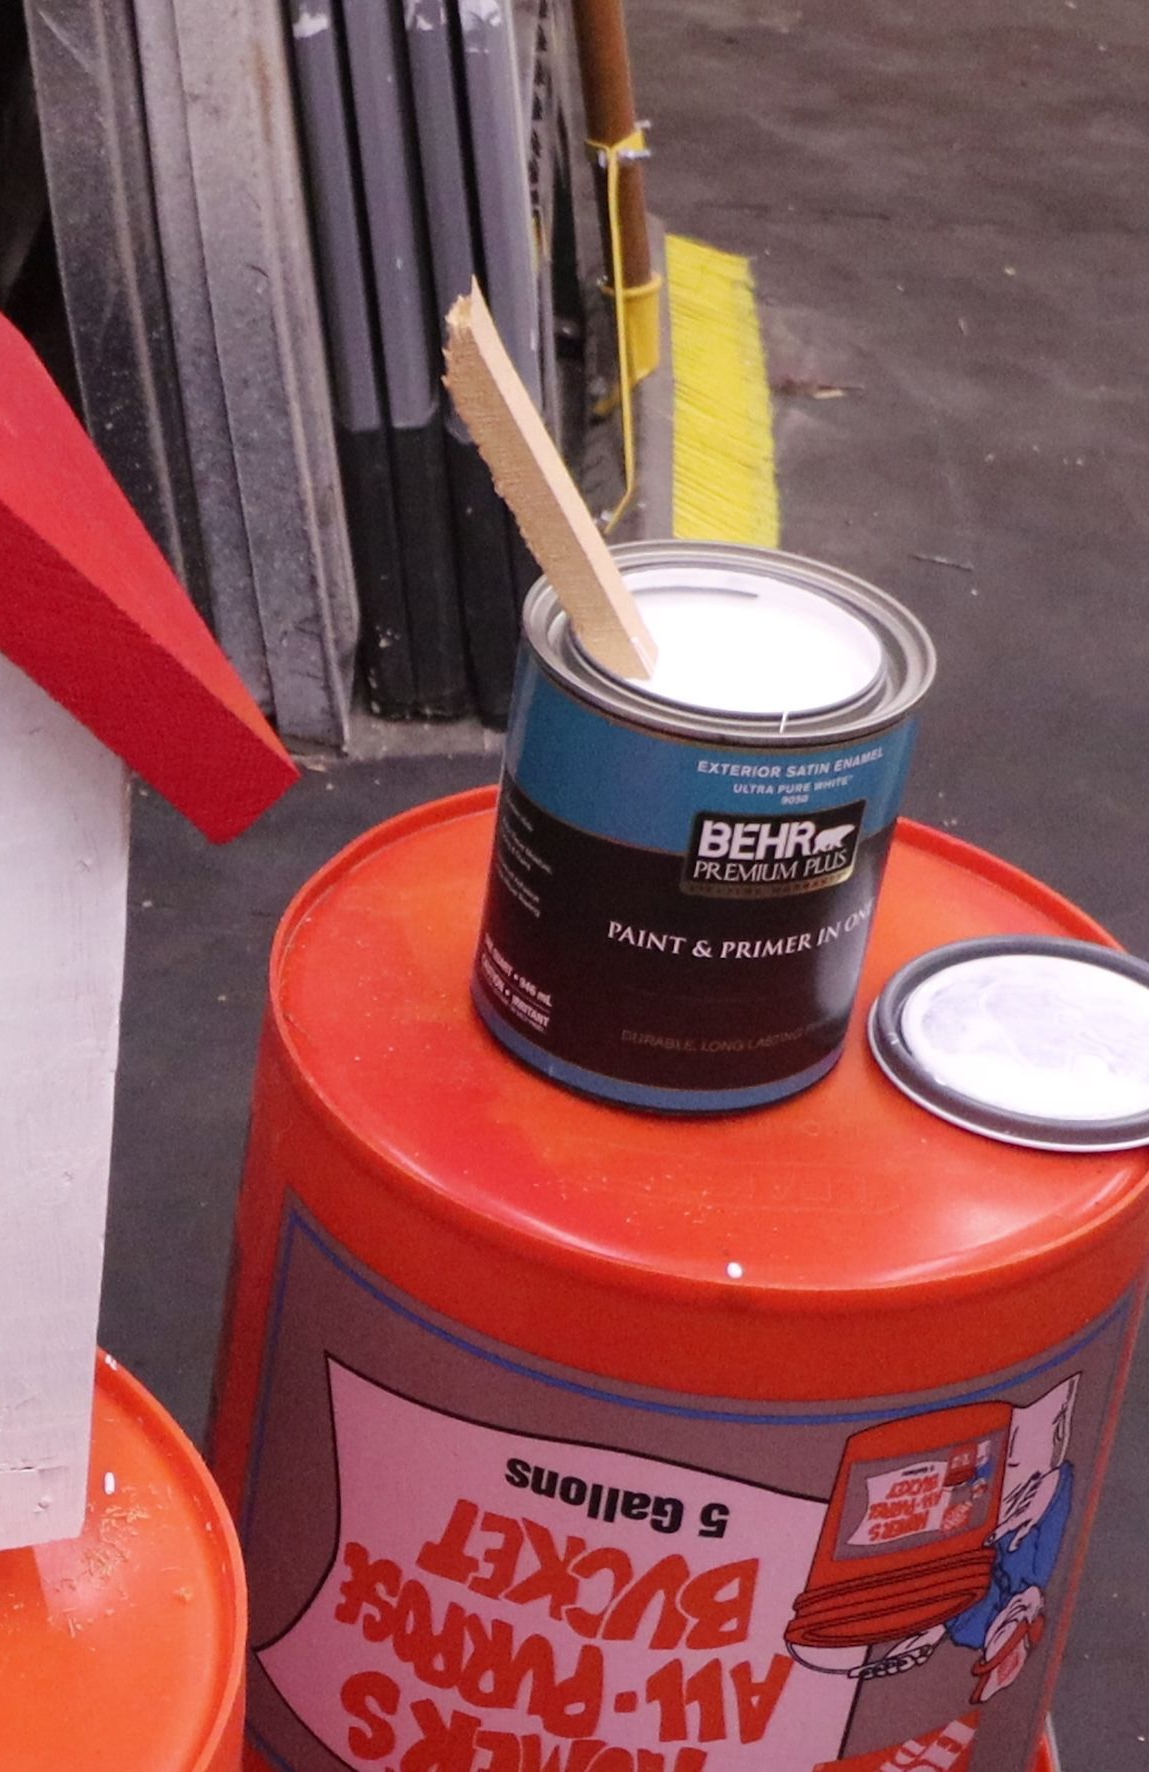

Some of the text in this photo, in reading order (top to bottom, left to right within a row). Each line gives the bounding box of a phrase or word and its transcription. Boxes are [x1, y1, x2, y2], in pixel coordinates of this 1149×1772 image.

[697, 747, 884, 778] EXTERIOR SATIN ENAMEL
[733, 784, 774, 795] ULTRA
[777, 782, 810, 794] PURE
[698, 820, 816, 861] BEHR
[693, 849, 847, 882] PREMIUM PLUS
[607, 921, 687, 955] PAINT
[692, 939, 713, 958] &
[720, 933, 812, 959] PRIMER
[816, 922, 842, 947] IN
[701, 1039, 746, 1052] LONG
[504, 1457, 729, 1539] 5 Gallons
[416, 1498, 760, 1651] BUCKET
